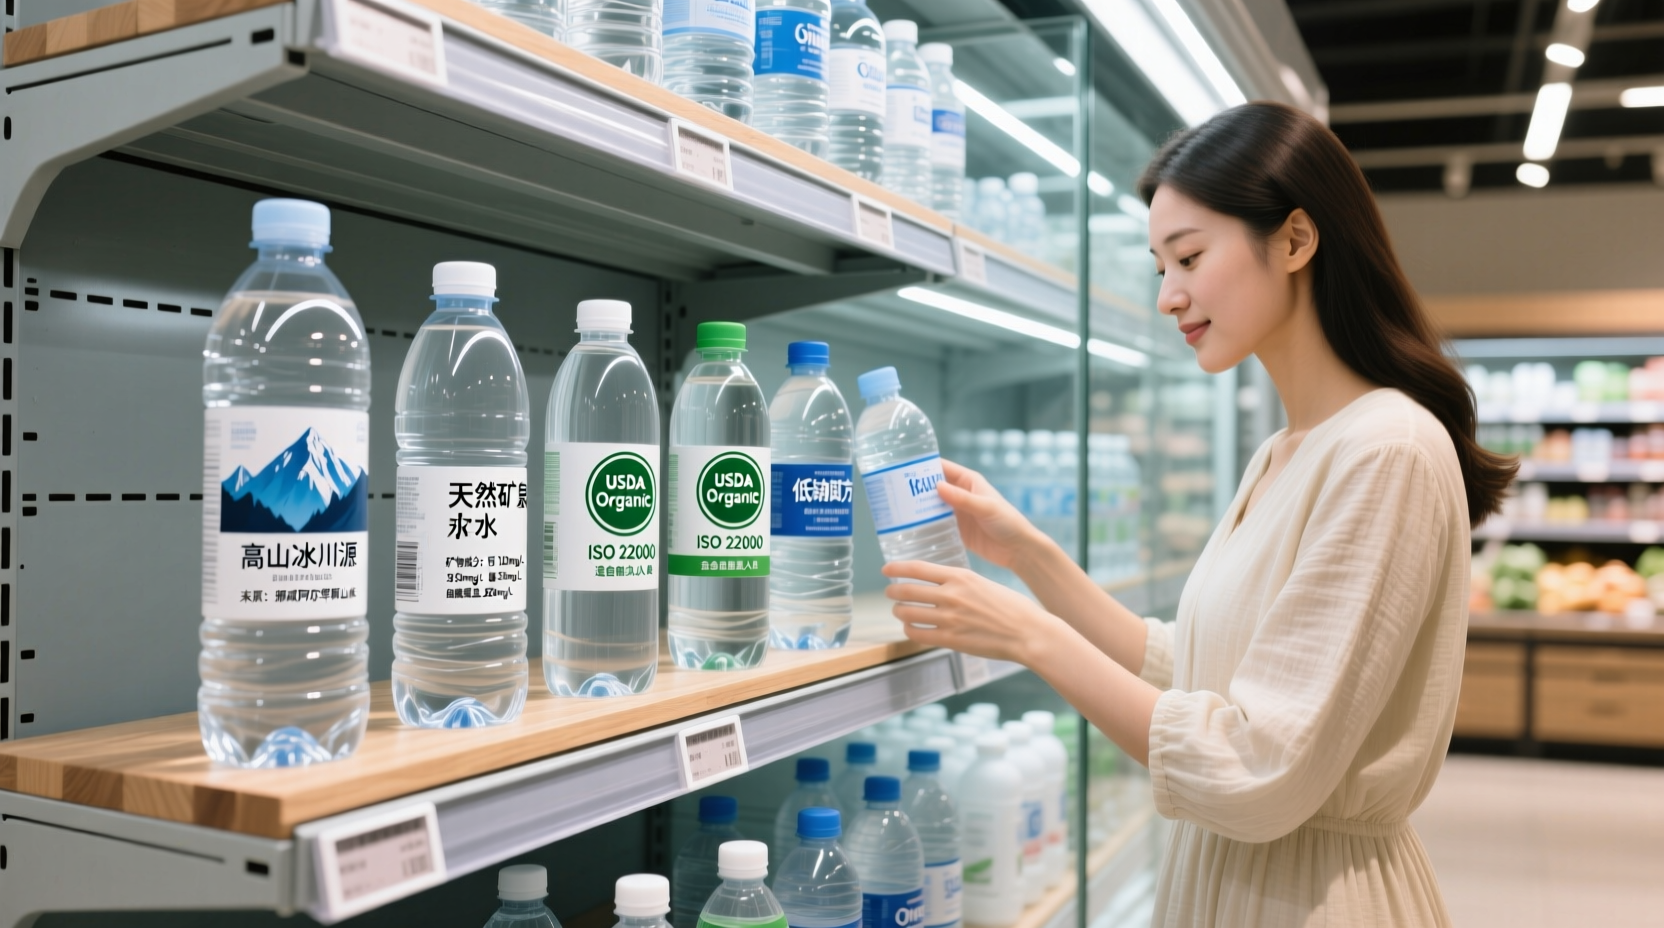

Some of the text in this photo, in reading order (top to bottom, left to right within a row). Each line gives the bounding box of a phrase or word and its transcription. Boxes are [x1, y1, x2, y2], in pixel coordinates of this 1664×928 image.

[605, 474, 646, 490] USDA
[715, 472, 753, 488] USDA
[596, 491, 652, 512] Organic
[706, 488, 759, 508] Organic
[697, 534, 764, 550] ISO 22000
[241, 541, 357, 570] 高山冰川源
[588, 543, 656, 560] ISO 22000
